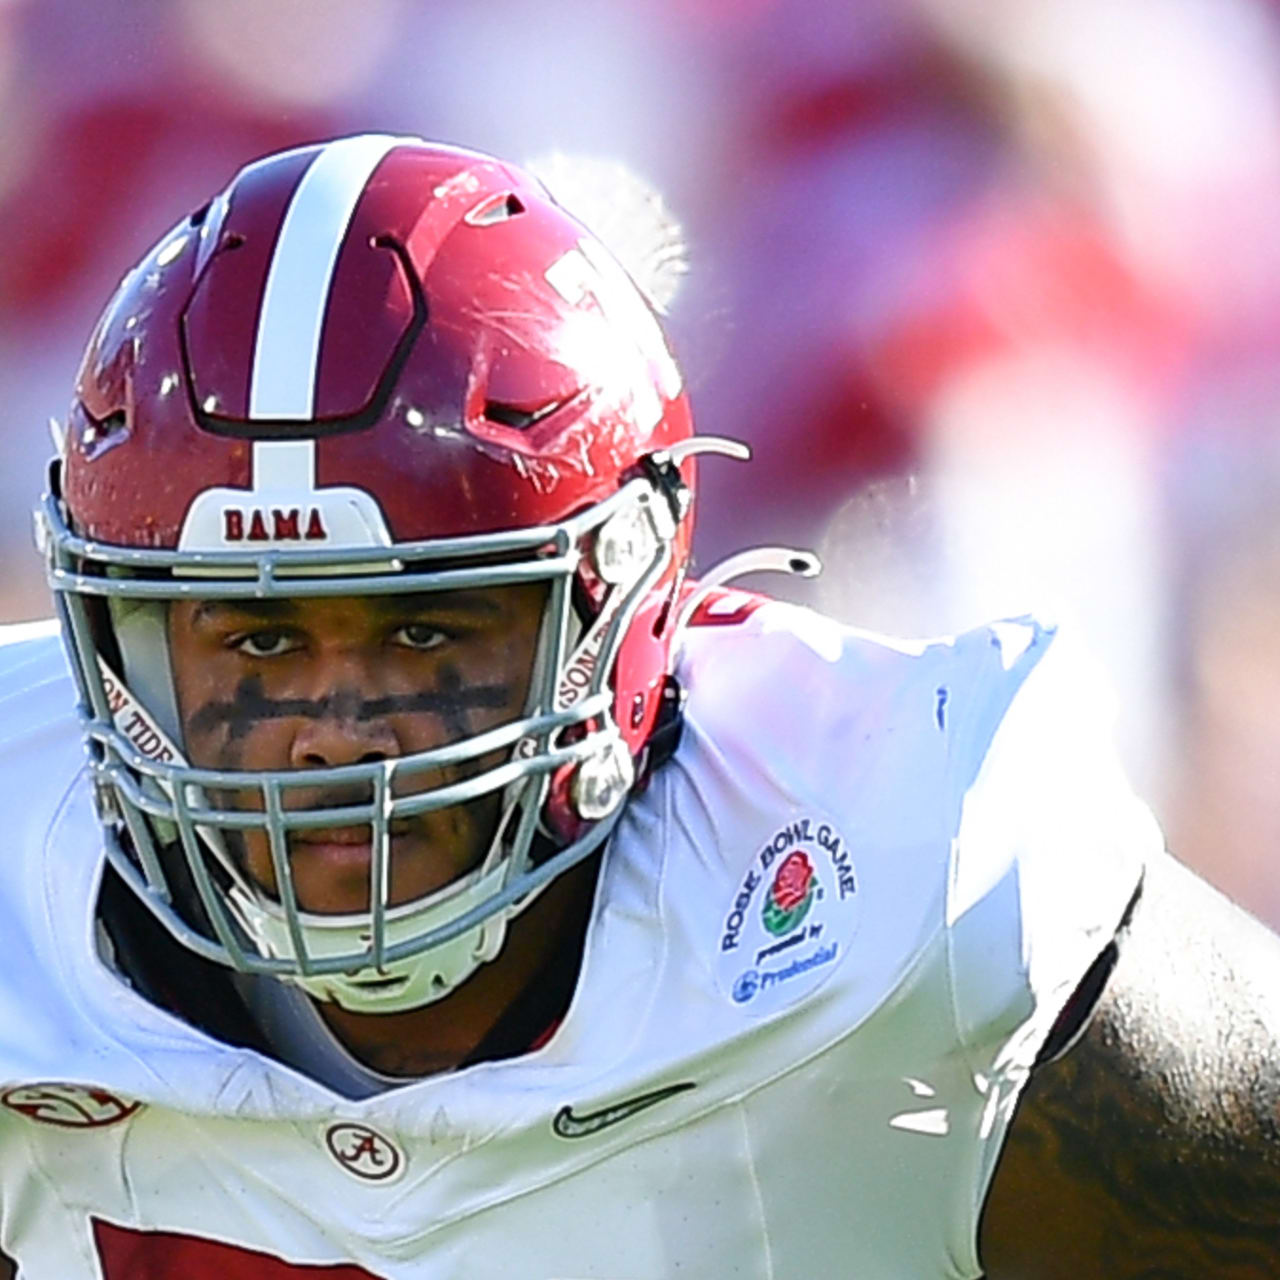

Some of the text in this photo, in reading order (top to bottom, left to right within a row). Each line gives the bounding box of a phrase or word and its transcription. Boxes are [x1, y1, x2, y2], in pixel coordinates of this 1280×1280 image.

[223, 507, 328, 541] BAMA
[721, 869, 762, 951] ROSE
[760, 818, 815, 870] BOWL
[817, 825, 856, 900] GAME
